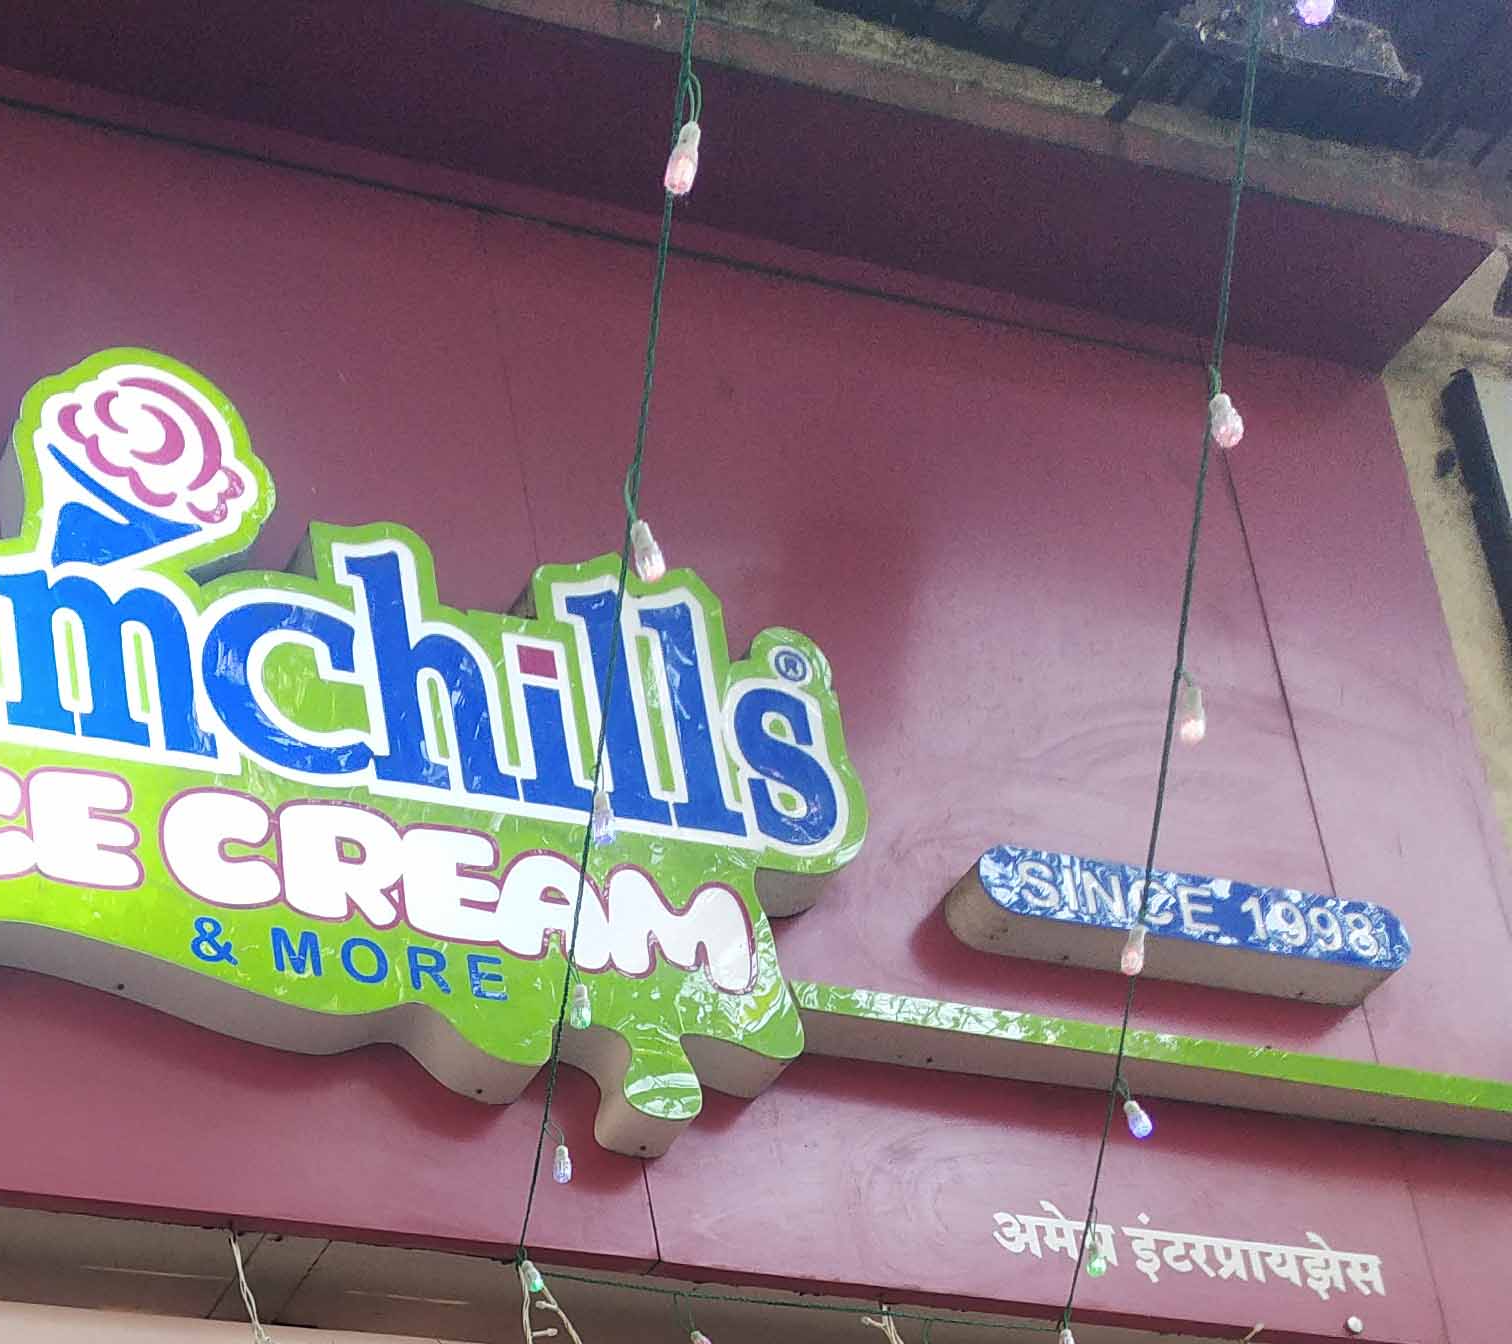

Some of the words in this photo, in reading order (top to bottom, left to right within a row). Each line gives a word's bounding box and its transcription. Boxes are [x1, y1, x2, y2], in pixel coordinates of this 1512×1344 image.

[158, 793, 755, 996] CREAM
[1019, 858, 1219, 937] SINCE
[1241, 895, 1379, 957] 1998
[191, 917, 238, 967] &
[272, 927, 508, 1002] MORE
